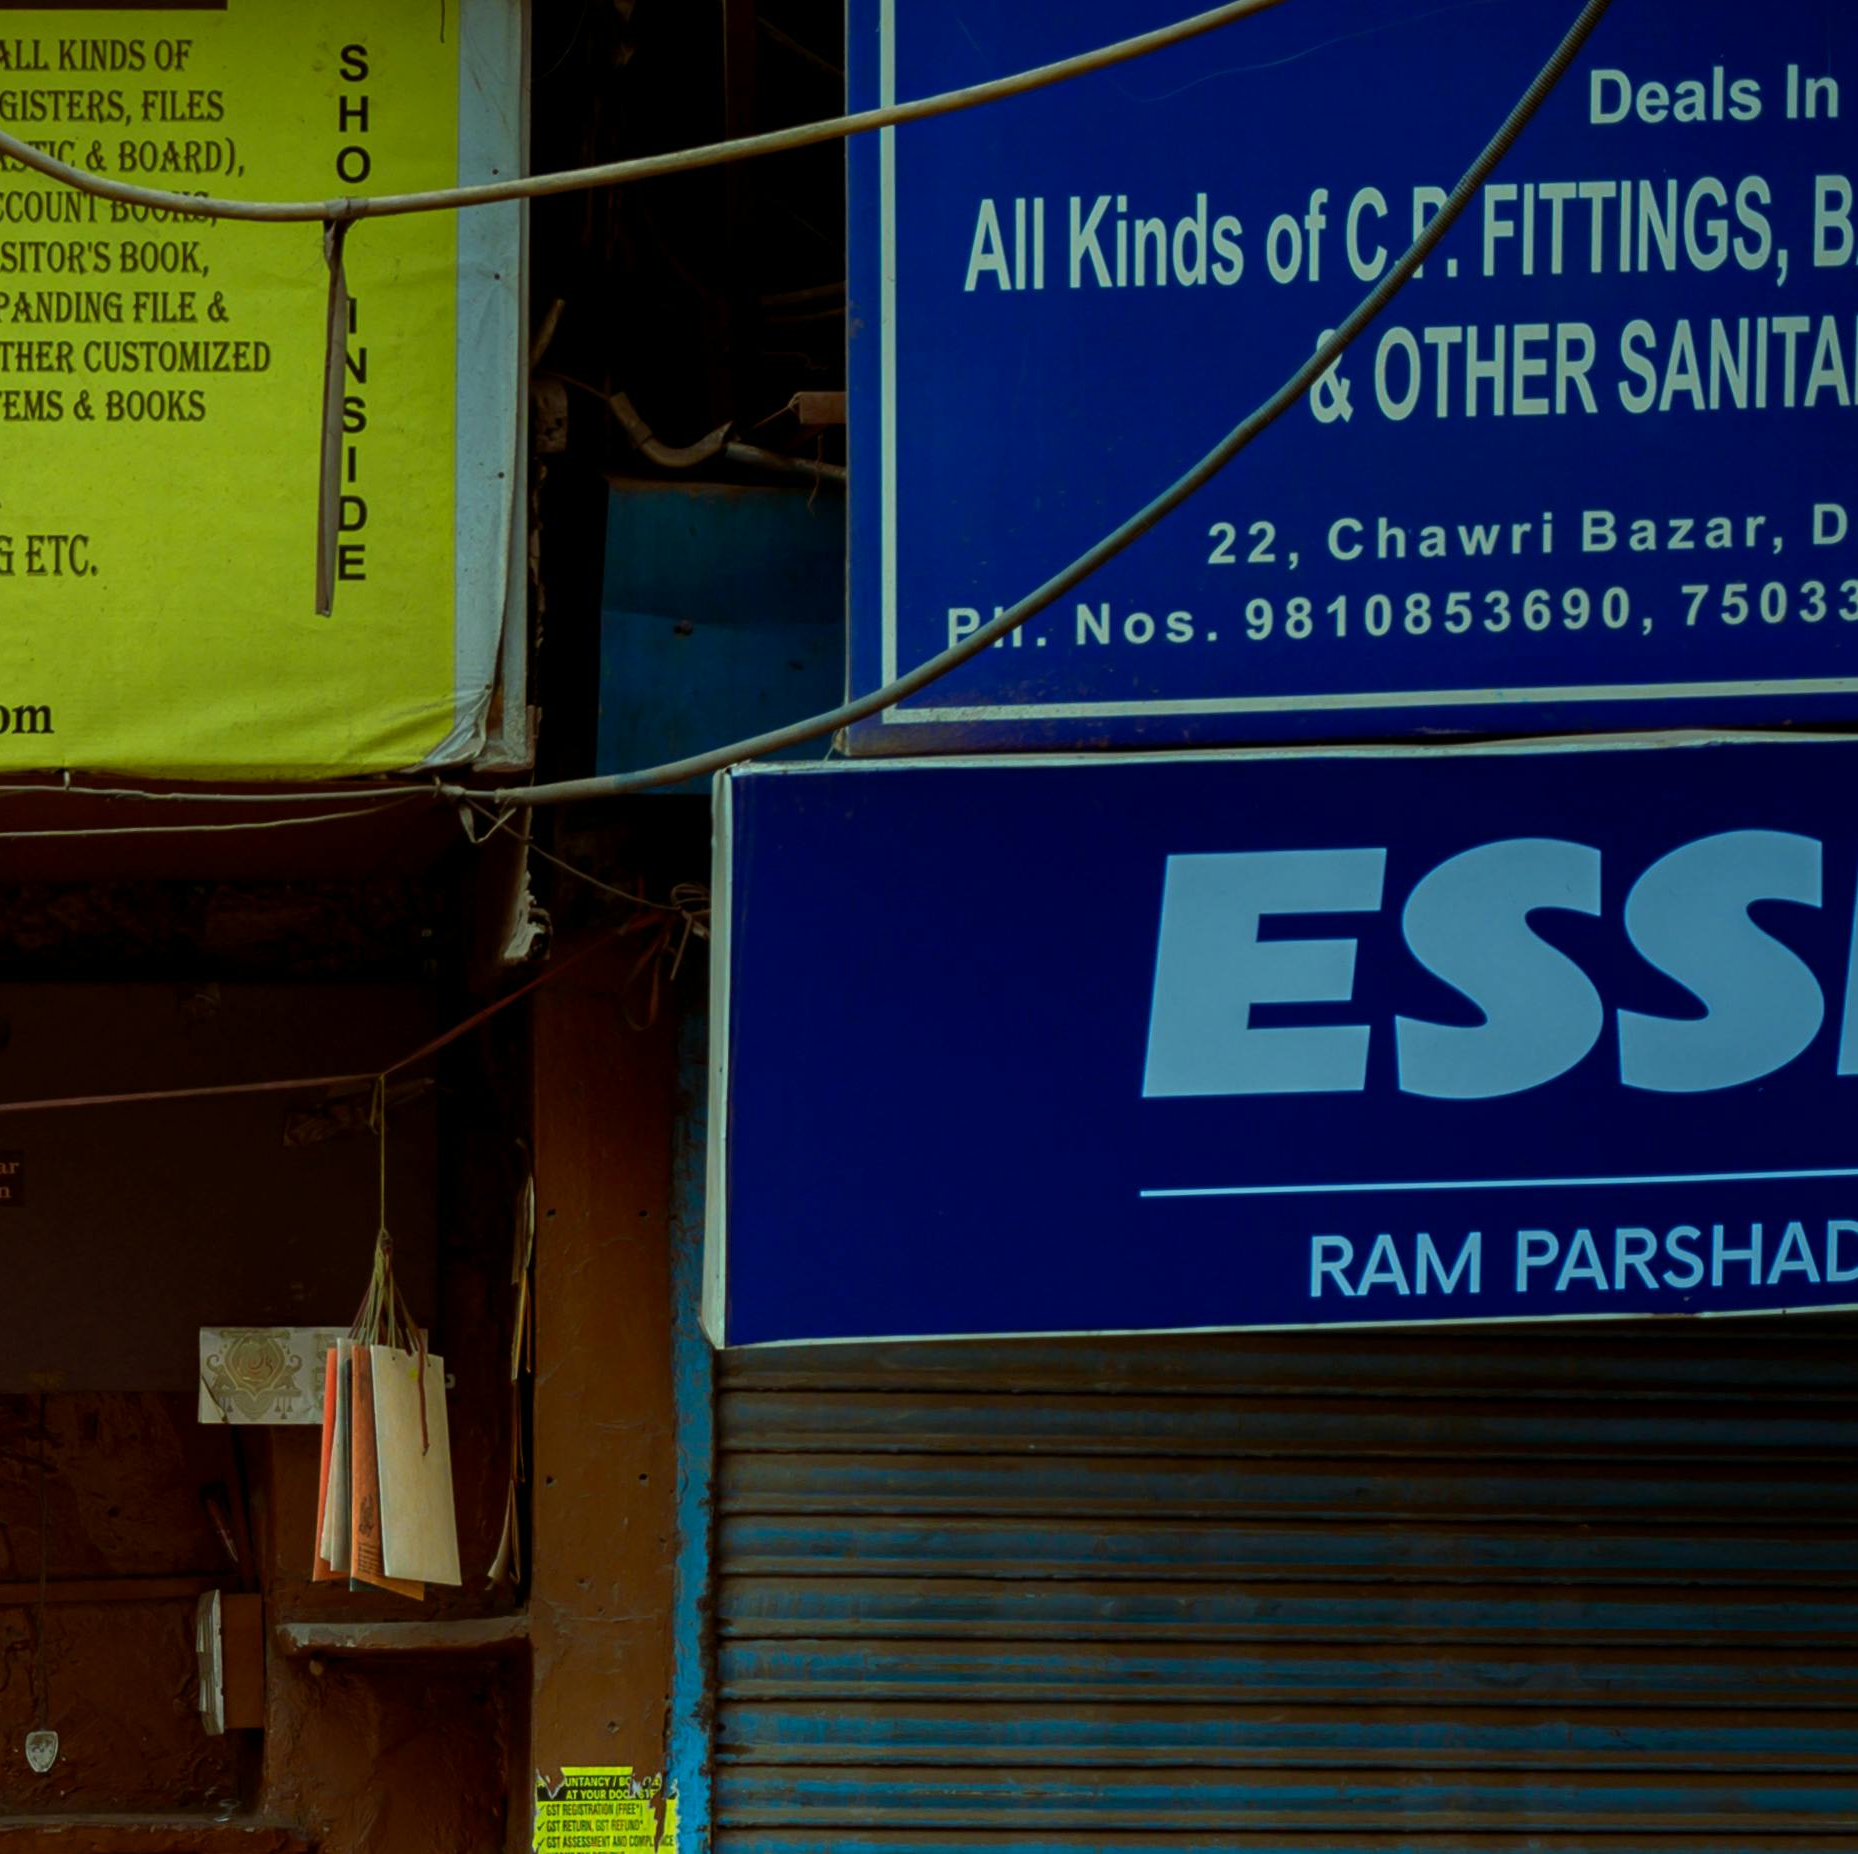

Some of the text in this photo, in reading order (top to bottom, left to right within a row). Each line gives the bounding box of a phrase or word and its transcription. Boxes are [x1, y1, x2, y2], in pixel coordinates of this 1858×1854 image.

[57, 38, 147, 72] KINDS
[153, 39, 194, 73] OF
[140, 89, 226, 122] FILES
[335, 43, 372, 188] SHO
[1588, 64, 1840, 125] Deals In
[85, 139, 108, 172] &
[116, 137, 245, 178] BOARD),
[118, 241, 211, 278] BOOK,
[963, 196, 1044, 292] All
[1069, 192, 1244, 289] Kinds
[1266, 188, 1327, 282] of
[1346, 184, 1459, 282] CP.
[1483, 173, 1789, 287] FITTINGS,
[132, 292, 197, 324] FILE
[207, 292, 230, 324] &
[82, 341, 272, 374] CUSTOMIZED
[1308, 313, 1858, 424] & OTHER SANITA
[72, 390, 94, 422] &
[104, 390, 207, 422] BOOKS
[337, 296, 368, 581] INSIDE
[23, 533, 100, 578] ETC.
[1206, 520, 1302, 570] 22,
[1327, 510, 1555, 563] Chawri
[1581, 503, 1784, 555] Bazar,
[1075, 602, 1220, 646] Nos.
[1244, 585, 1653, 643] 9810853690,
[1141, 828, 1858, 1101] ESS
[1310, 1217, 1858, 1299] RAM PARSHAD
